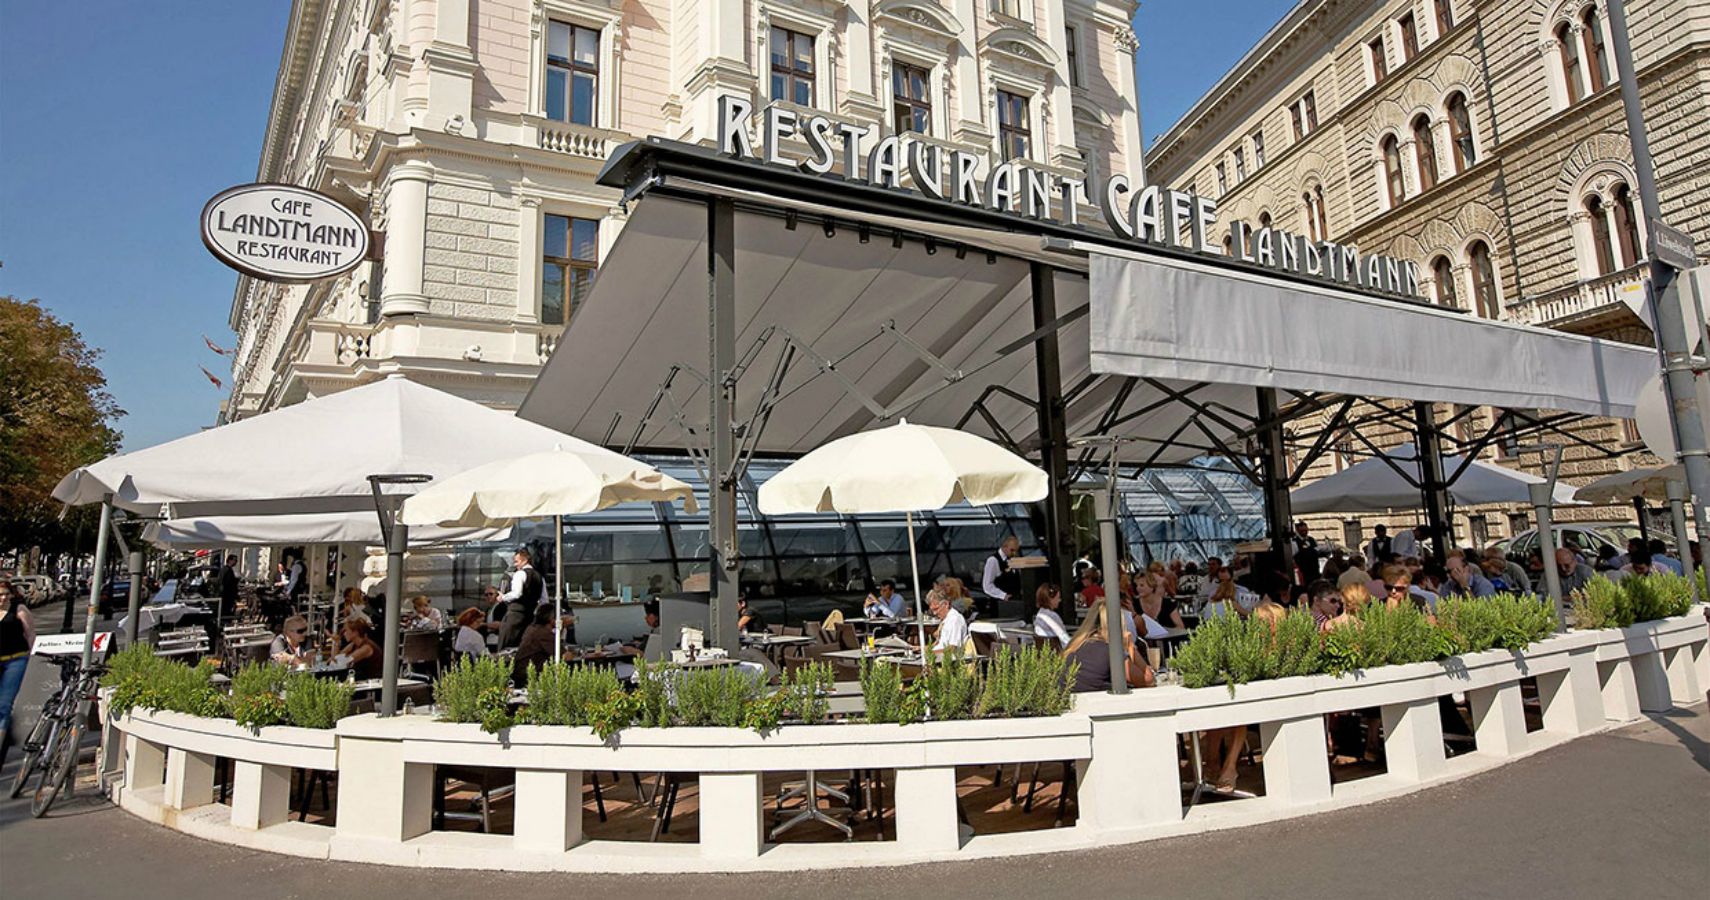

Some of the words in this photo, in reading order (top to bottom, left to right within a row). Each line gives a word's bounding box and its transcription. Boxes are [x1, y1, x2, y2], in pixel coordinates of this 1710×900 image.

[271, 197, 313, 217] CAFE
[717, 94, 1083, 227] RESTAURANT
[1102, 174, 1221, 254] CAFE
[1230, 219, 1421, 297] LANDTMANN
[217, 211, 357, 248] LANDTMANN
[237, 240, 341, 266] RESTAURANT
